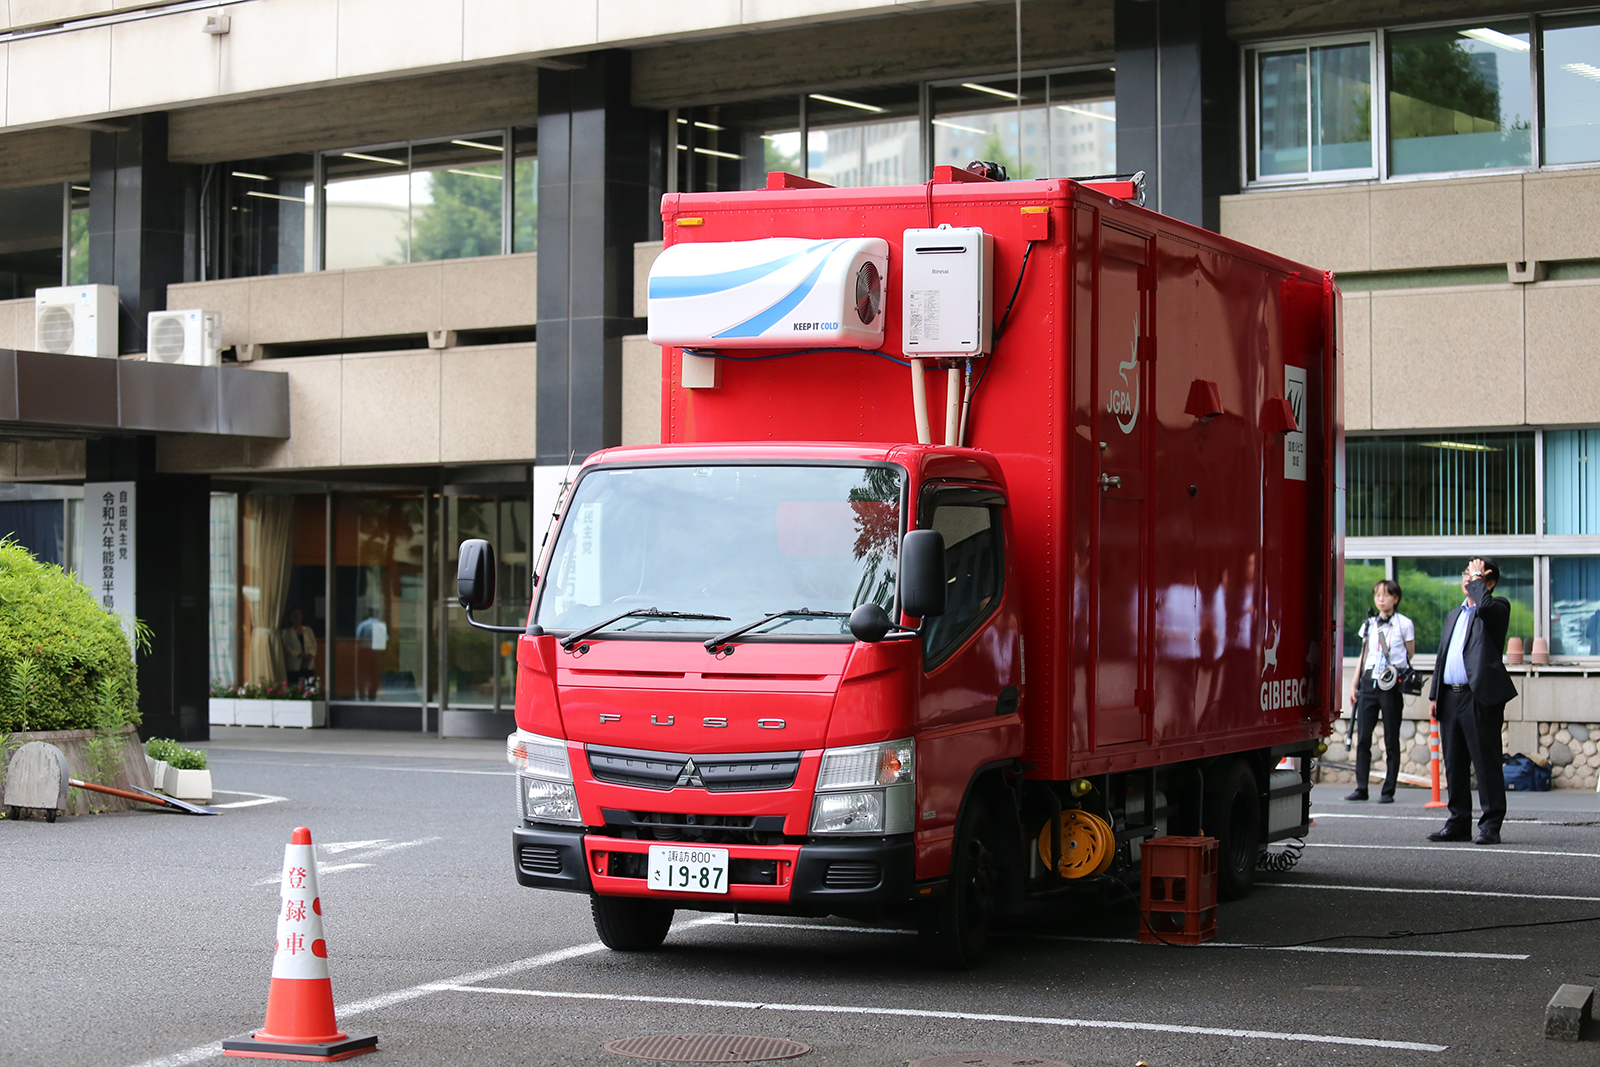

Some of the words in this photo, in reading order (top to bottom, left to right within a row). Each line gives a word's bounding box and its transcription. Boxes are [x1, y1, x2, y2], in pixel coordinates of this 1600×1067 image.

[793, 322, 812, 331] KEEP
[812, 322, 820, 331] IT
[820, 321, 838, 330] COLD
[1106, 388, 1132, 416] JGPA
[118, 490, 128, 560] 自由民主党
[102, 491, 115, 615] 令和六年能登半島
[1260, 677, 1318, 712] GIBIERCA
[599, 712, 787, 730] FUSO
[654, 869, 661, 881] さ
[668, 864, 724, 890] 19-87
[283, 866, 308, 956] 登録車
